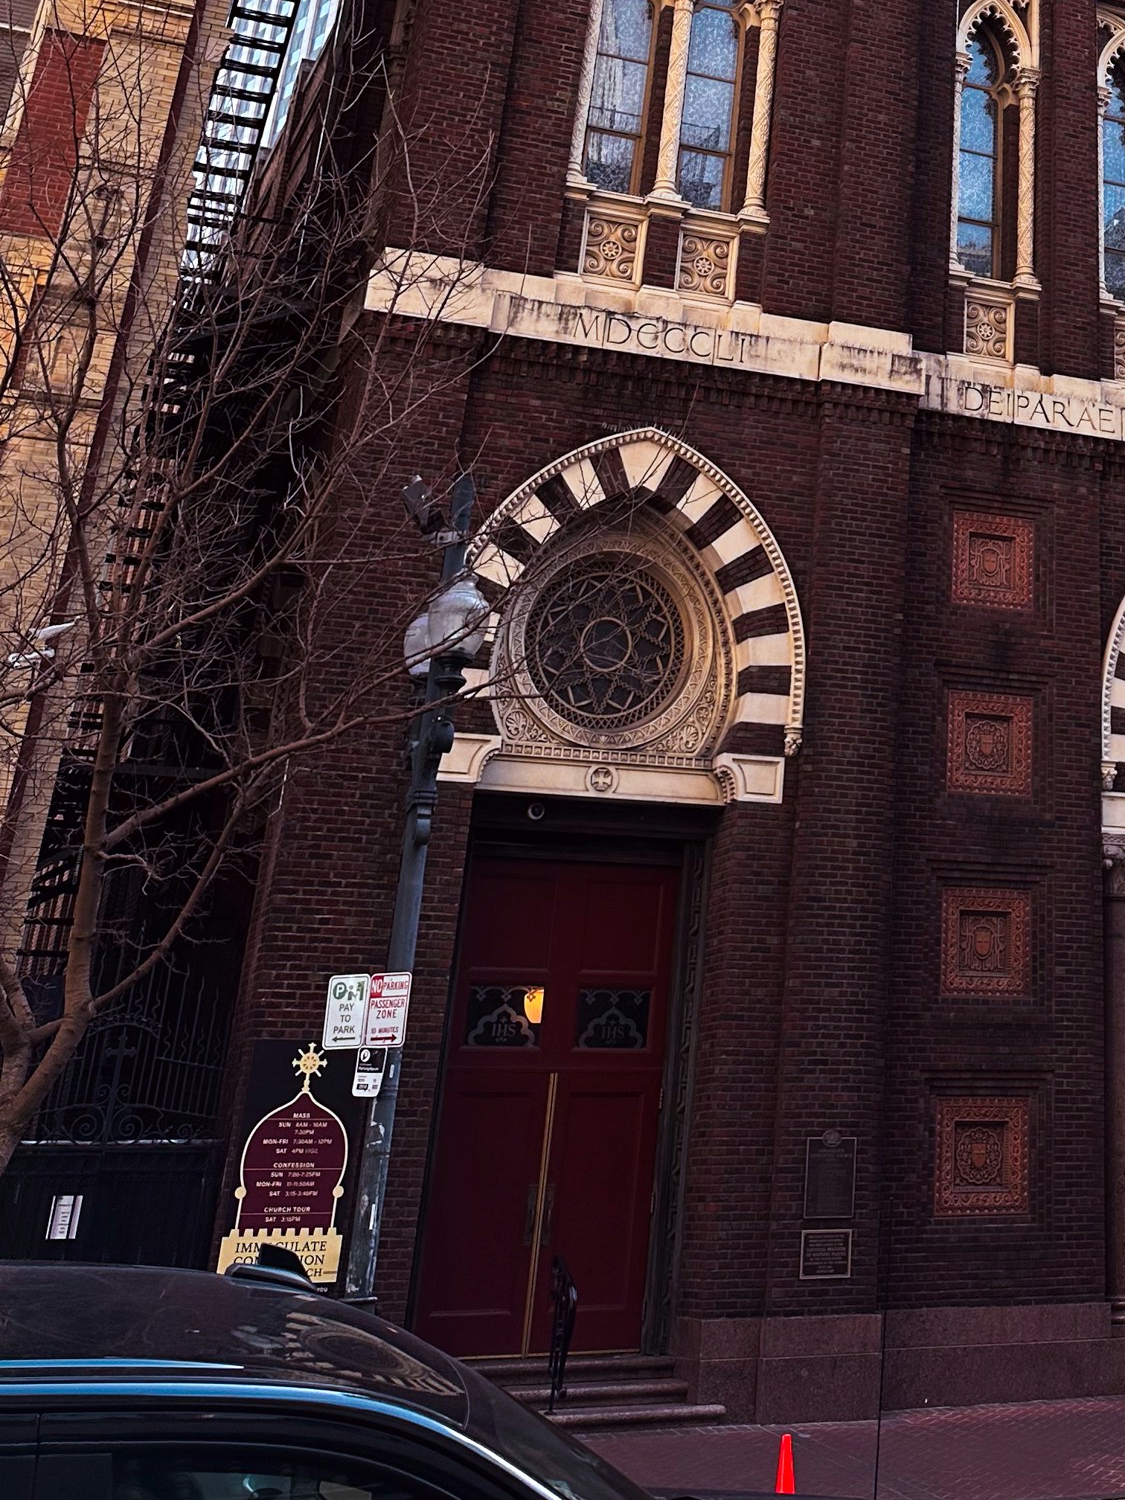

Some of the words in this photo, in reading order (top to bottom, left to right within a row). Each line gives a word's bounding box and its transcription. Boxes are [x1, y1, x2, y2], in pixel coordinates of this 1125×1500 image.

[573, 313, 746, 364] MDCCCLI
[963, 385, 1116, 434] DEIPARAE
[371, 979, 383, 994] NO
[384, 981, 409, 990] PARKING
[339, 1003, 355, 1012] PAY
[370, 998, 405, 1009] PASSENGER
[340, 1014, 351, 1023] TO
[376, 1009, 397, 1019] ZONE
[333, 1025, 355, 1034] PARK
